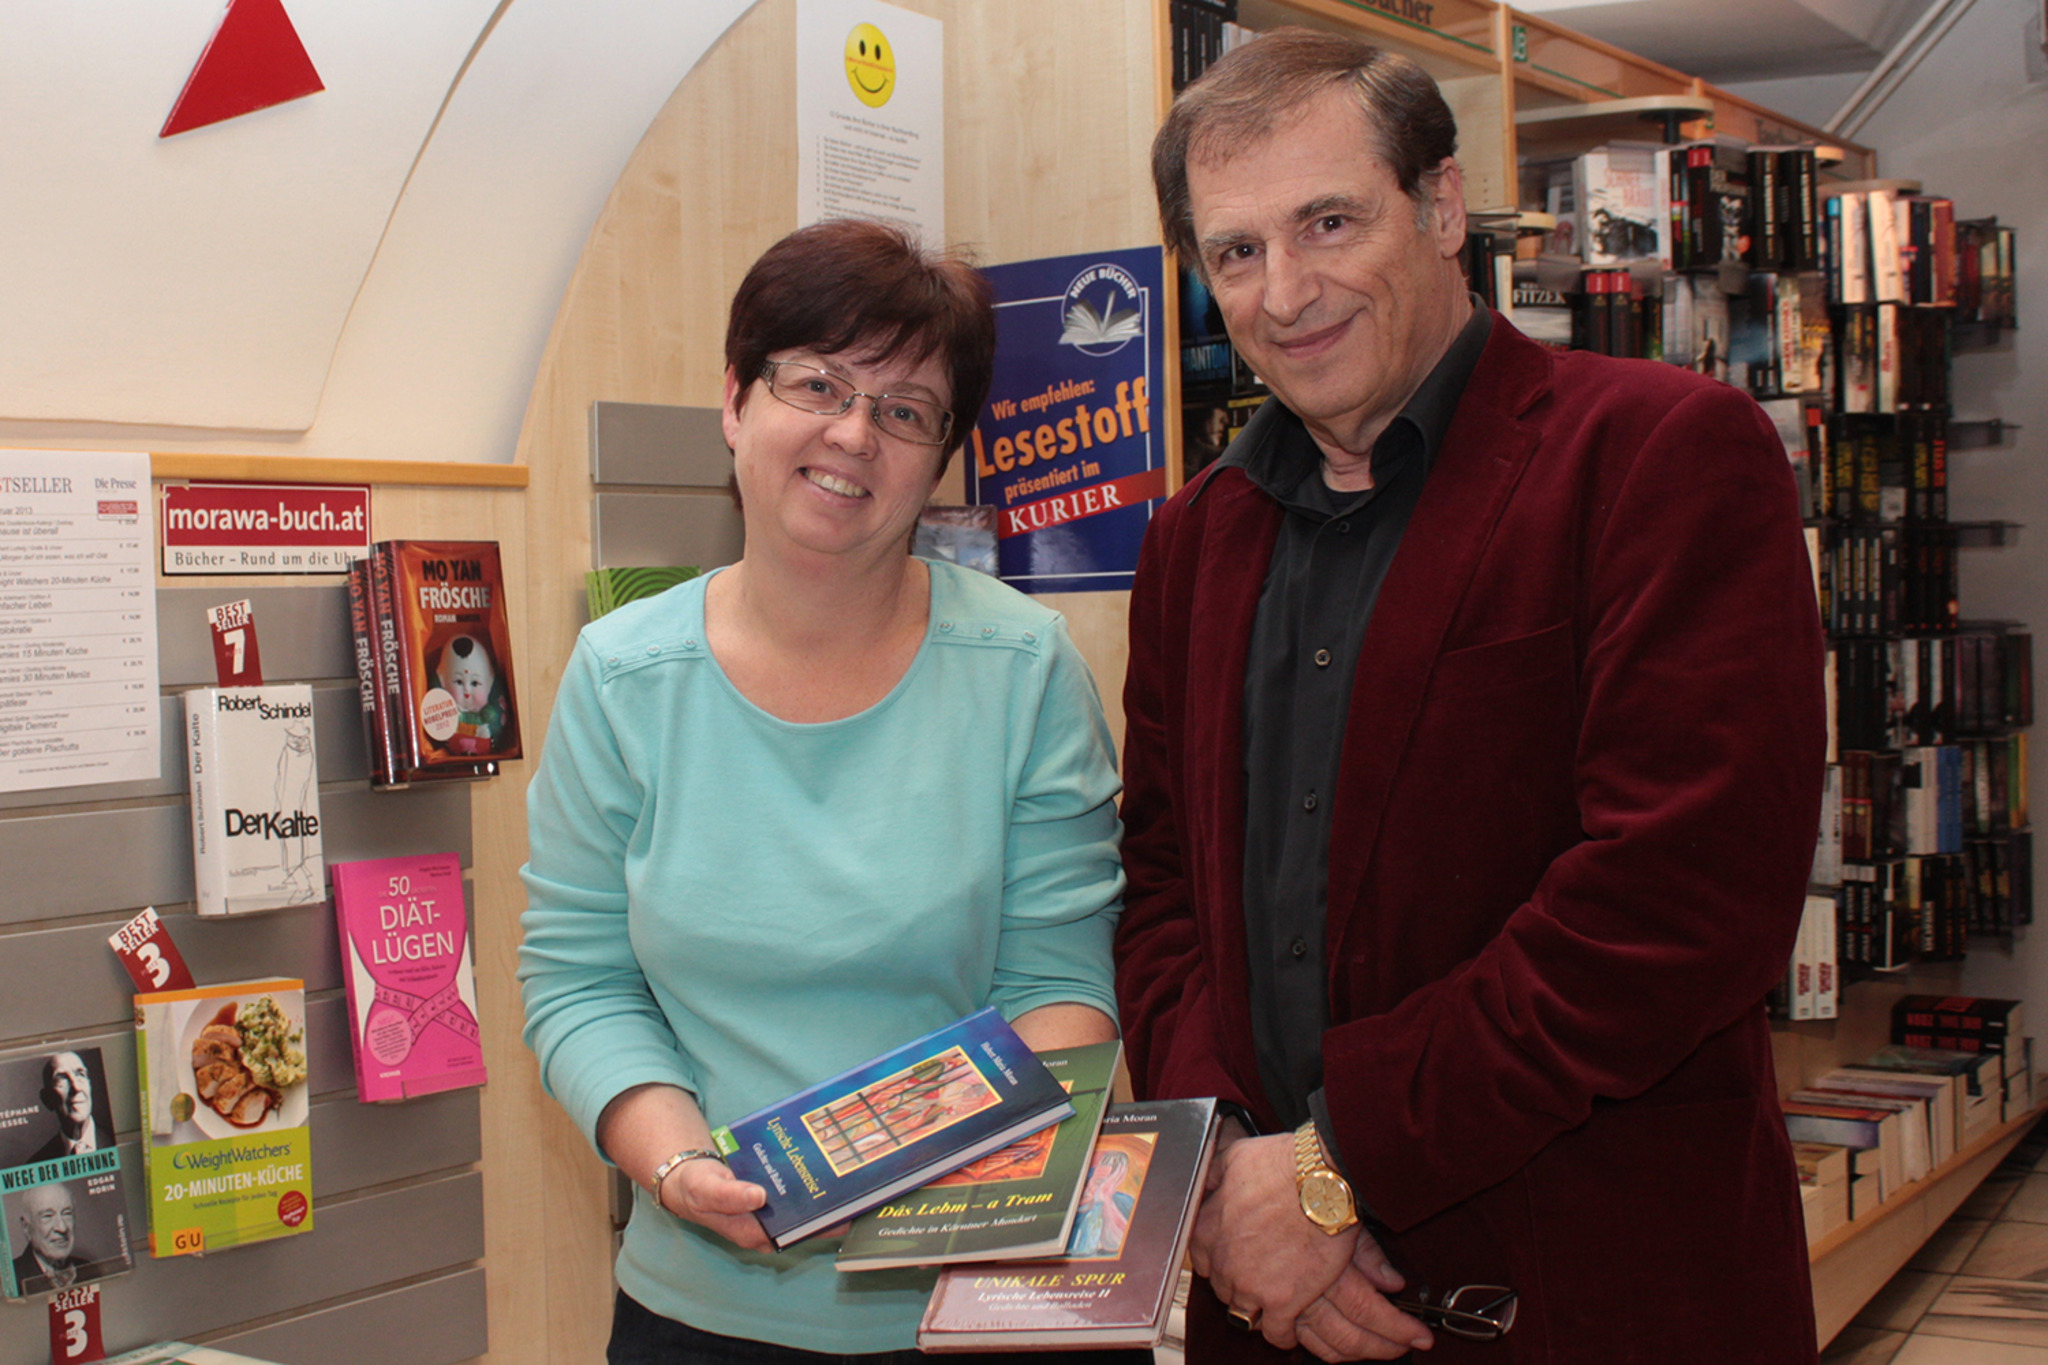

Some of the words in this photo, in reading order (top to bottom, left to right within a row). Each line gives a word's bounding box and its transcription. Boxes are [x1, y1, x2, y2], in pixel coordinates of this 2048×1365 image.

[1070, 269, 1097, 299] NEUE
[1098, 267, 1136, 300] BÜCHER
[991, 397, 1017, 421] Wir
[1021, 379, 1095, 414] empfehlen:
[971, 376, 1150, 478] Lesestoff
[94, 478, 109, 489] Die
[110, 478, 137, 490] Presse
[1004, 466, 1078, 504] präsentiert
[1081, 461, 1100, 479] im
[168, 501, 365, 531] morawa-buch.at
[1008, 484, 1122, 533] KURIER
[175, 551, 225, 566] Bücher
[241, 552, 276, 566] Rund
[282, 555, 301, 566] um
[309, 552, 329, 566] die
[422, 560, 448, 582] MO
[450, 560, 482, 581] YAN
[419, 582, 492, 609] FRÖSCHE
[215, 601, 247, 623] BEST
[215, 614, 250, 632] SELLER
[434, 614, 456, 623] ROMAN
[223, 628, 246, 675] 7
[380, 619, 400, 695] FRÖSCHE
[355, 637, 376, 713] FRÖSCHE
[218, 695, 262, 713] Robert
[260, 702, 312, 720] Schindel
[388, 875, 411, 897] 50
[380, 896, 441, 931] DIÄT-
[117, 912, 152, 944] BEST
[121, 924, 159, 956] SELLER
[371, 930, 455, 965] LÜGEN
[136, 942, 171, 990] 3
[1122, 1113, 1158, 1123] Moran
[766, 1116, 793, 1150] Lyrische
[1, 1169, 36, 1190] WEGE
[38, 1162, 60, 1181] DER
[62, 1151, 116, 1177] HOFFNUNG
[87, 1174, 116, 1187] EDGAR
[164, 1163, 304, 1202] 20-MINUTEN-KÜCHE
[88, 1182, 116, 1196] MORIN
[916, 1201, 968, 1217] Lebm
[986, 1199, 1000, 1211] a
[1004, 1193, 1054, 1208] Tram
[878, 1226, 925, 1238] Gedichte
[927, 1225, 939, 1234] in
[990, 1214, 1039, 1228] Mundart
[973, 1274, 1065, 1290] UNIKALE
[1070, 1272, 1127, 1287] SPUR
[977, 1291, 1027, 1303] Lyrische
[1028, 1289, 1097, 1301] Lebensreise
[1098, 1287, 1112, 1299] II
[54, 1293, 95, 1313] SELLER
[65, 1310, 88, 1358] 3
